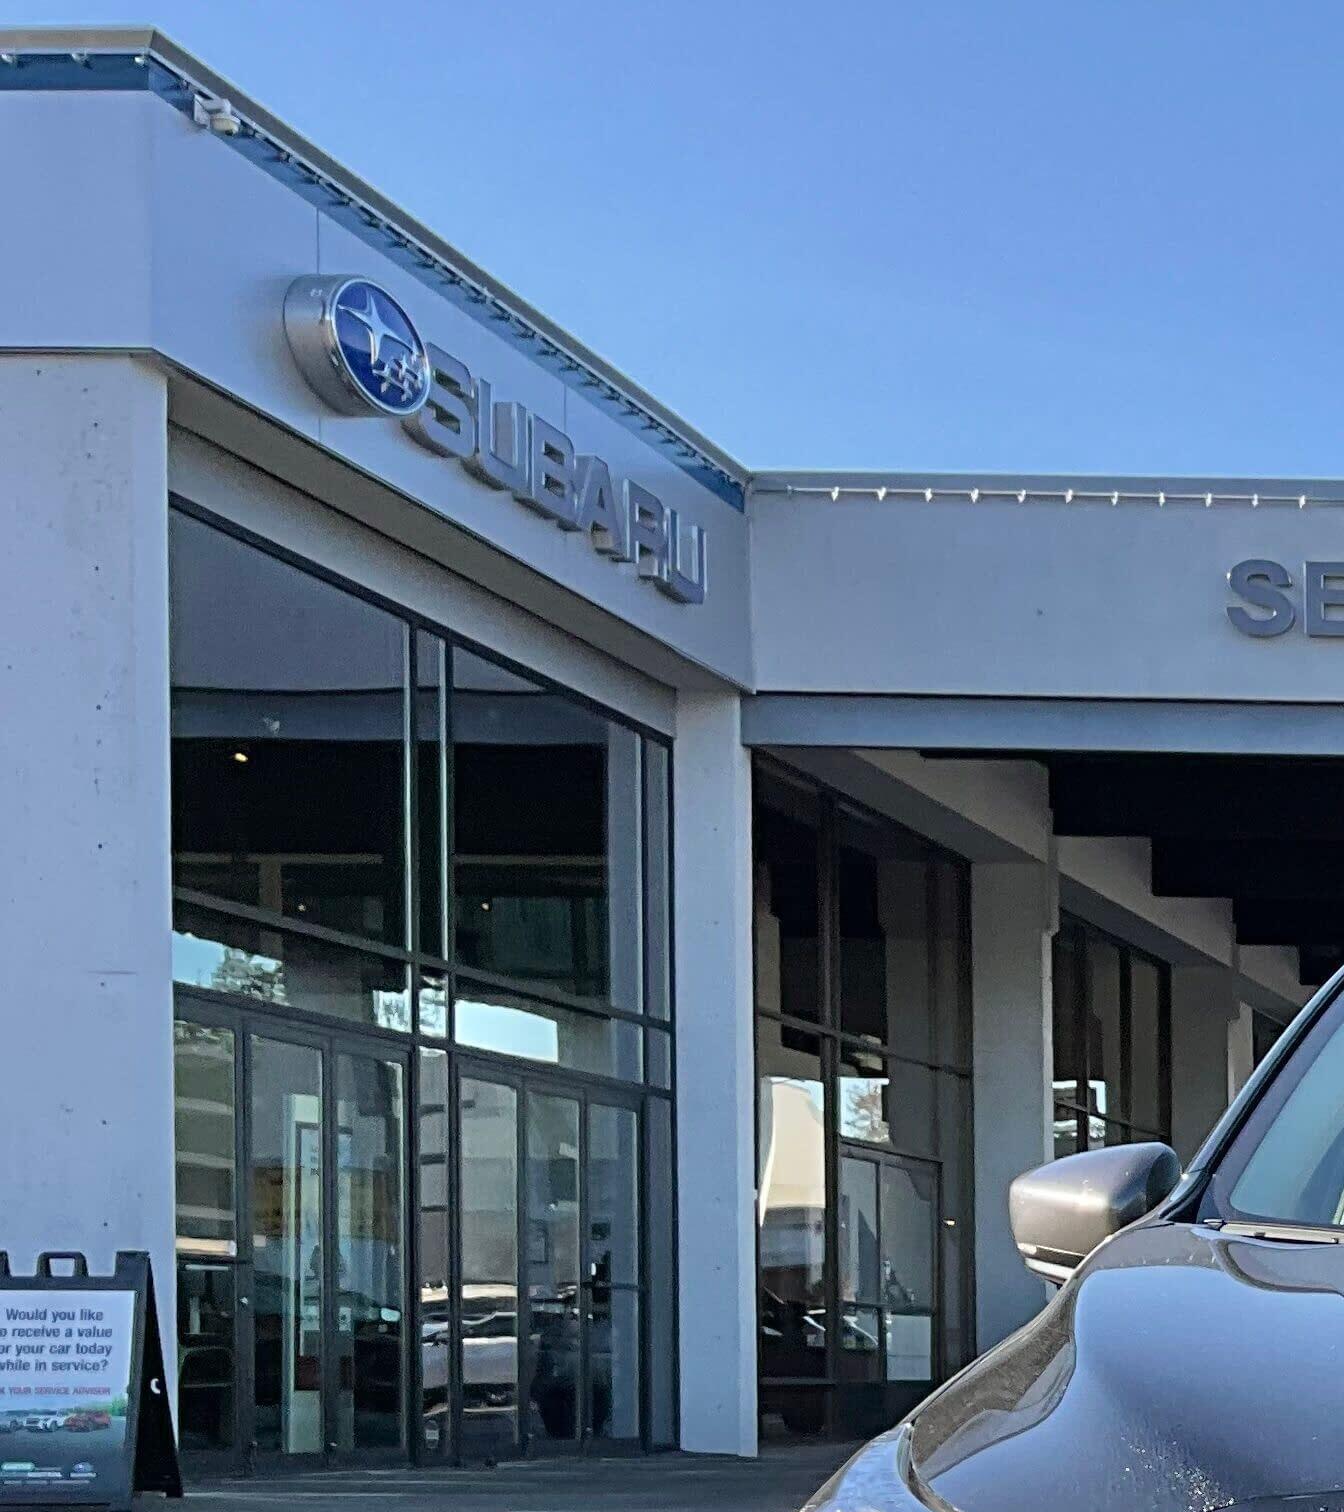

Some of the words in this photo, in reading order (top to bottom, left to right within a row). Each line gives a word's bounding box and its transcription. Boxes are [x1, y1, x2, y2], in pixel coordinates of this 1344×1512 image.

[404, 341, 707, 604] SUBARU
[6, 1308, 48, 1321] Would
[51, 1310, 76, 1323] you
[80, 1308, 104, 1321] like
[11, 1325, 61, 1338] receive
[65, 1327, 73, 1338] a
[77, 1325, 113, 1338] value
[15, 1344, 45, 1357] your
[49, 1344, 71, 1355] car
[75, 1342, 113, 1357] today
[34, 1359, 47, 1371] in
[51, 1359, 109, 1371] service?
